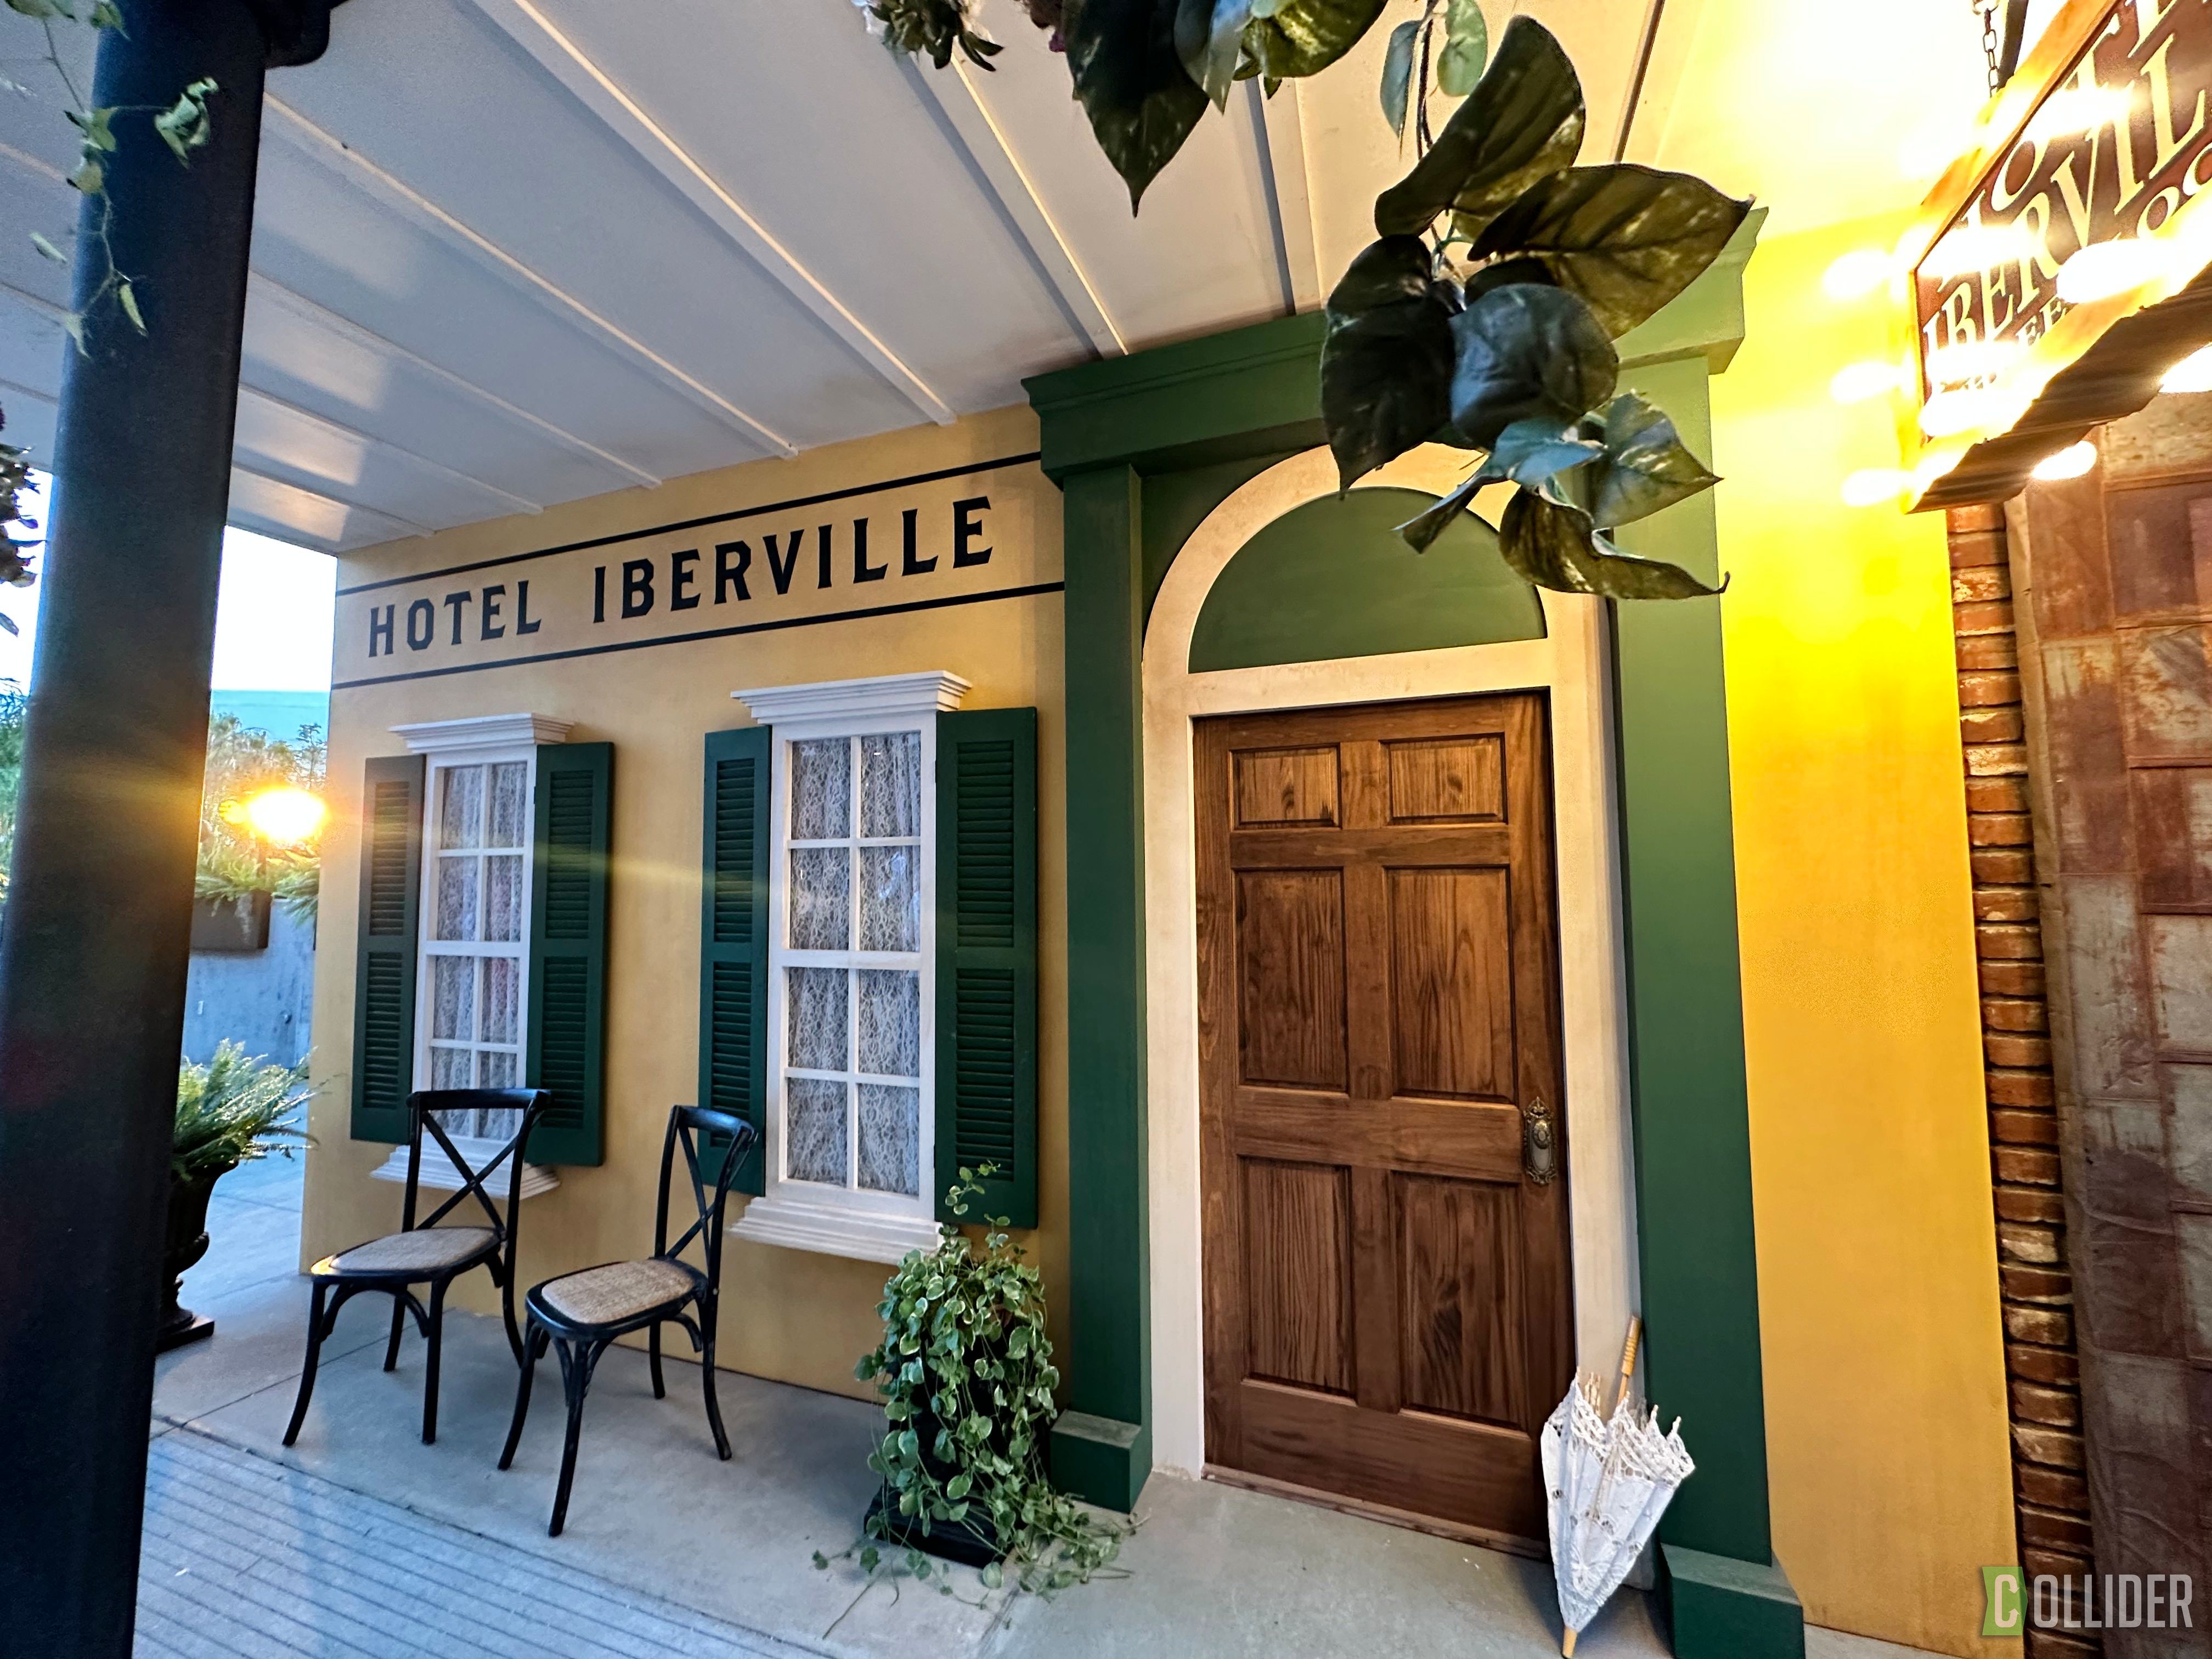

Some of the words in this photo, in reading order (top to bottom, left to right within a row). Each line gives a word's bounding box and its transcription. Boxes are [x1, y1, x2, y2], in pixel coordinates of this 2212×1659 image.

[1922, 33, 2212, 366] IBERVIL
[369, 580, 542, 658] HOTEL
[592, 495, 994, 624] IBERVILLE
